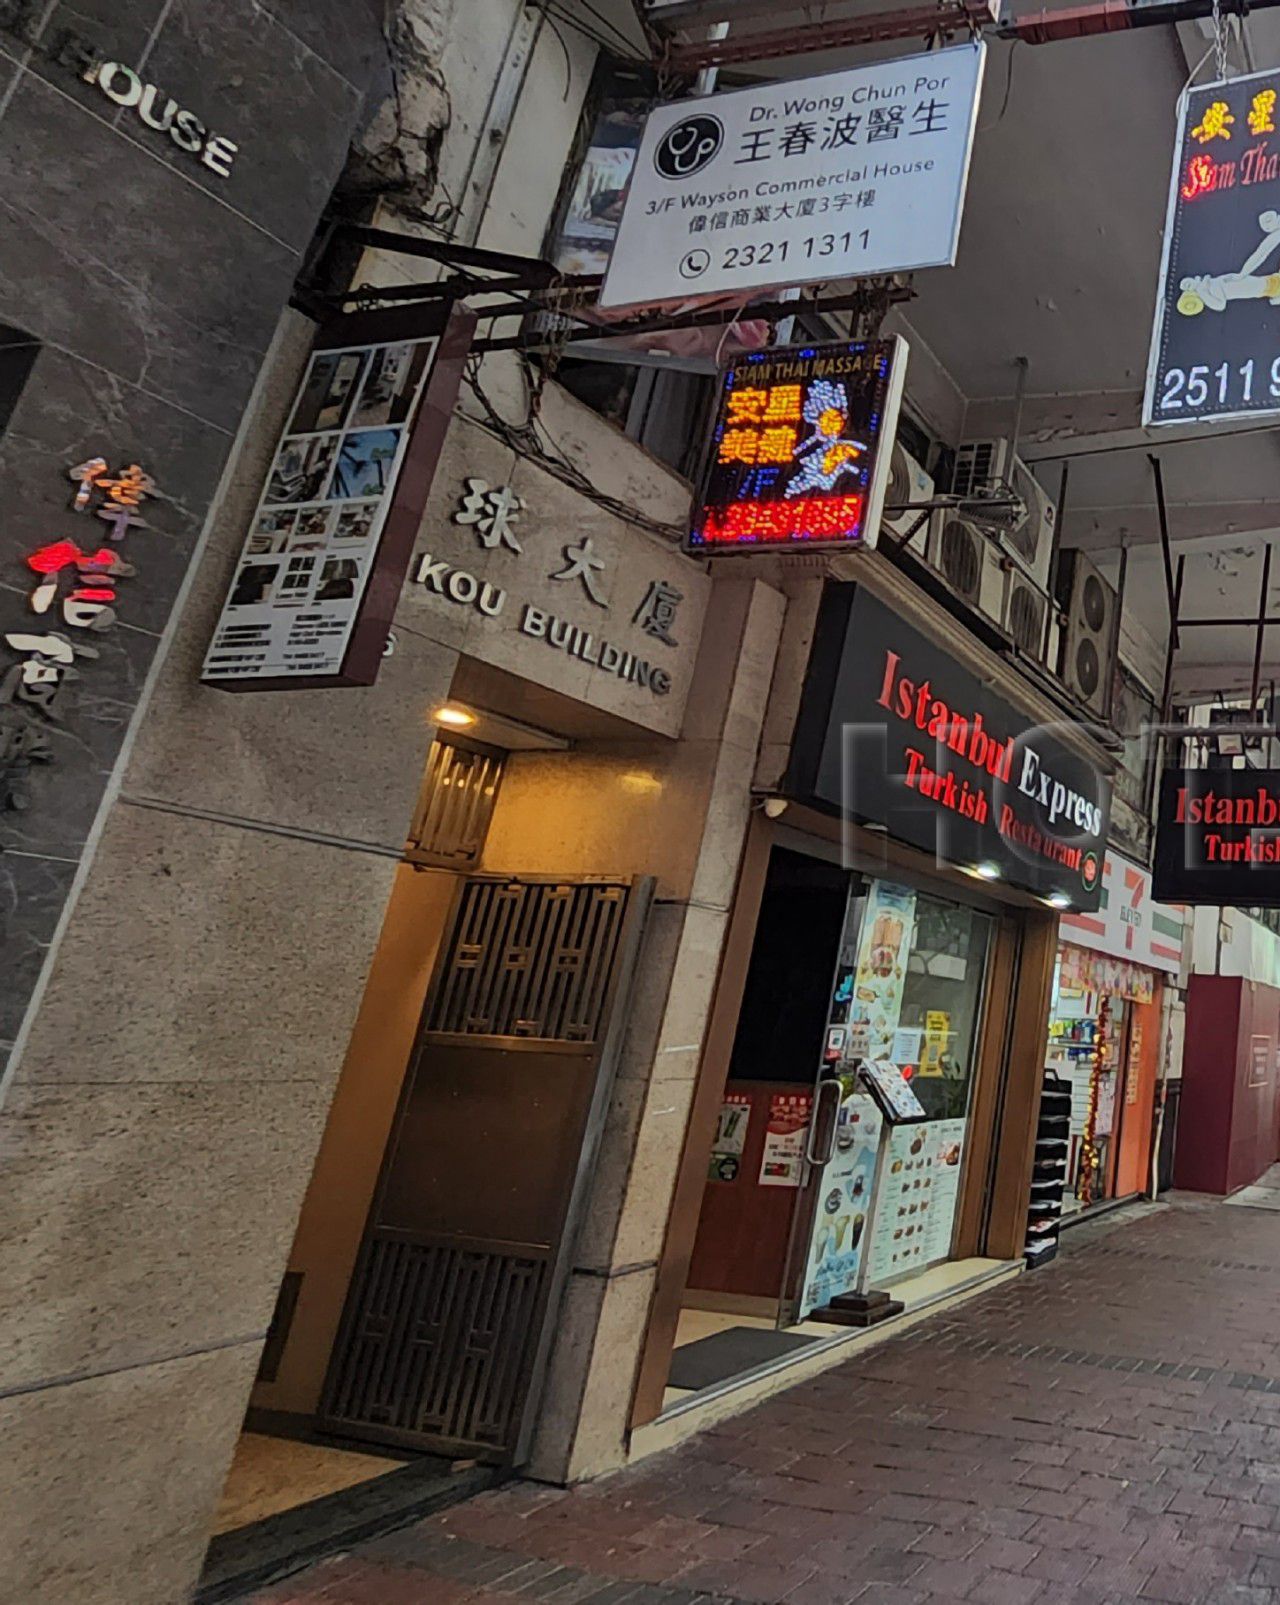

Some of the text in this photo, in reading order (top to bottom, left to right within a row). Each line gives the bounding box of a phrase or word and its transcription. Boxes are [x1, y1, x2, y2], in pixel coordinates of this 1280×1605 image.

[750, 76, 949, 124] Dr. Wong Chun Por
[733, 98, 950, 165] 王春波醫生
[645, 158, 936, 216] 3/F Wayson Commercial House
[721, 229, 872, 270] 2321 1311
[733, 363, 770, 383] SIAM
[774, 359, 810, 379] THAI
[1160, 359, 1254, 410] 2511
[416, 553, 673, 696] KOU BUILDING
[874, 650, 1102, 837] Istanbul Express
[904, 747, 1083, 872] Turkish Restaurant
